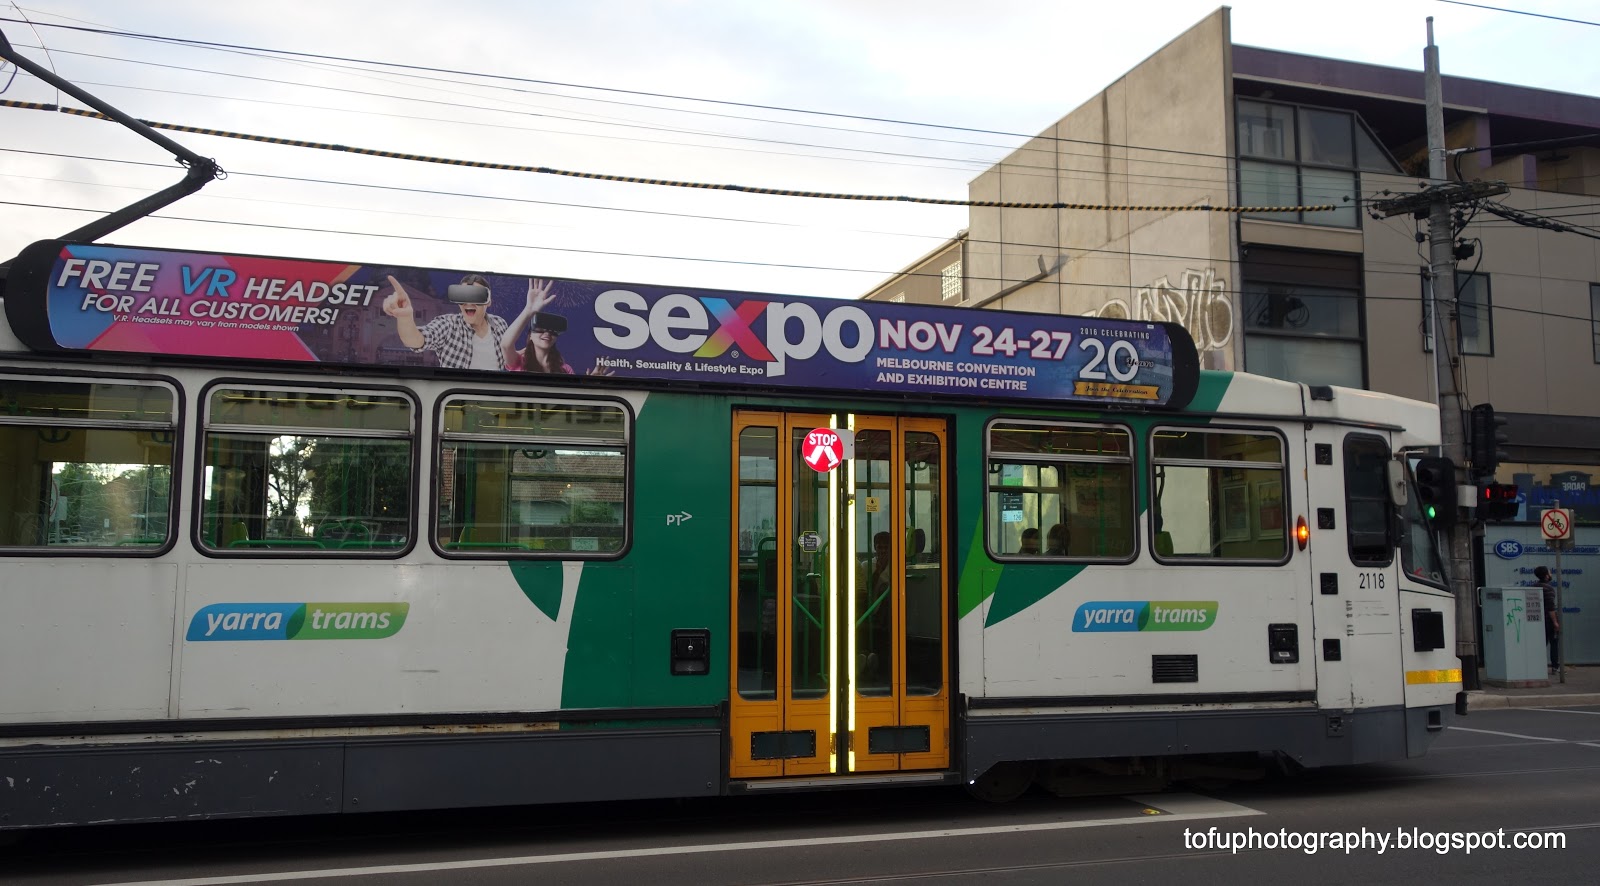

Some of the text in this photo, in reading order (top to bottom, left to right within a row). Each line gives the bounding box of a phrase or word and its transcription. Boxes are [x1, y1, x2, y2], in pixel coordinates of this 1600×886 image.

[56, 259, 379, 307] FREE VR HEADSET
[81, 293, 339, 325] FOR ALL CUSTOMERS!
[132, 316, 173, 325] Headsets
[174, 319, 195, 327] may
[196, 320, 216, 328] vary
[217, 321, 238, 329] from
[239, 322, 270, 331] models
[272, 324, 300, 332] shown
[592, 289, 876, 377] sexpo
[1080, 327, 1150, 339] 2016 CELEBRATING
[879, 318, 1072, 360] NOV 24-27
[596, 357, 764, 375] Health, Sexuality & Lifestyle Expo
[877, 357, 1036, 377] MELBOURNE CONVENTION
[1079, 338, 1139, 382] 20
[877, 372, 1027, 391] AND EXHIBITION CENTRE
[809, 433, 838, 446] STOP
[1501, 543, 1519, 552] SBS
[1359, 573, 1385, 589] 2118
[205, 609, 391, 636] yarra trams
[1084, 606, 1206, 628] yarra trams
